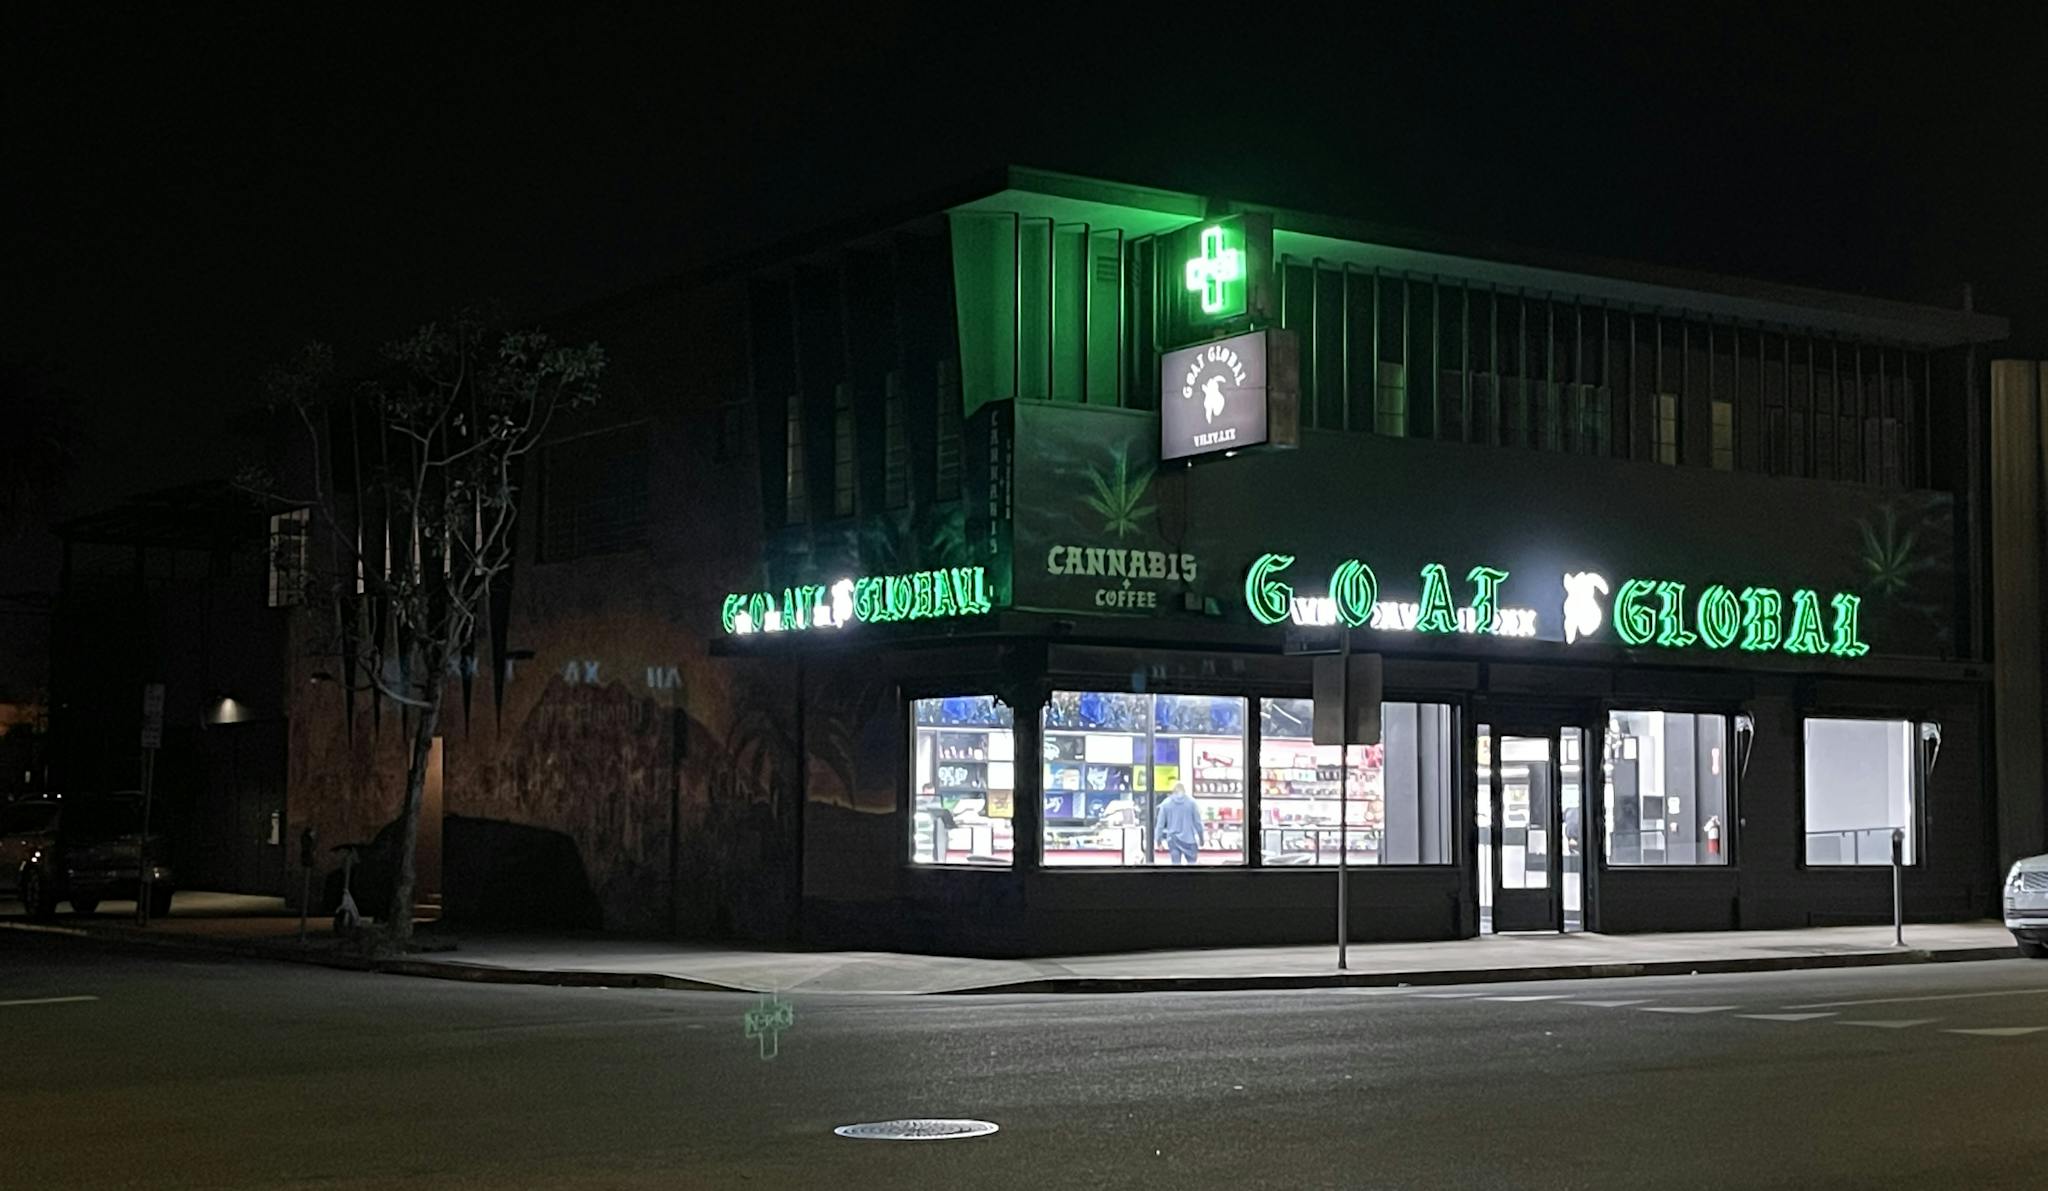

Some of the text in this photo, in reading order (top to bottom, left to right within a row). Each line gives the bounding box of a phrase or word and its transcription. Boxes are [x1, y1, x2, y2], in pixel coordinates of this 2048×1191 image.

[1182, 345, 1247, 399] GOAT GLOBAL
[1047, 545, 1198, 582] CANNABIS
[1095, 589, 1157, 608] COFFEE
[1246, 553, 1870, 657] GOAT GLOBAL
